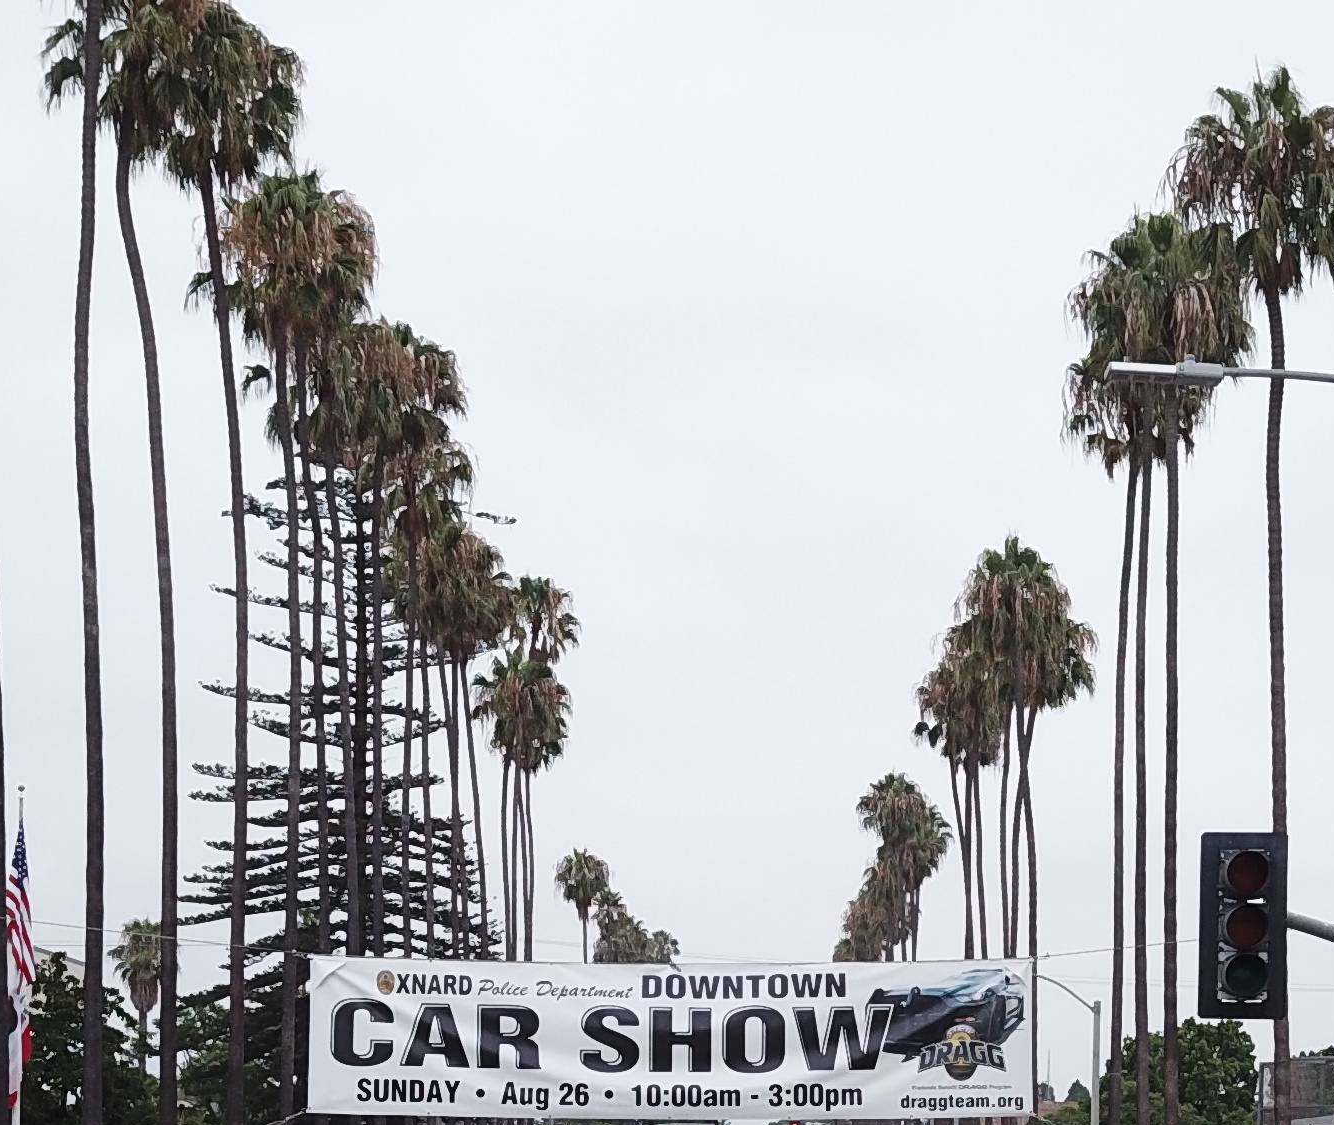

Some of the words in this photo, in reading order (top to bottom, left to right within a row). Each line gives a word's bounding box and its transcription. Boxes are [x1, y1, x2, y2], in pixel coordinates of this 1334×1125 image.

[477, 978, 529, 997] Police
[535, 980, 634, 1001] Department
[641, 972, 847, 999] DOWNTOWN
[329, 997, 542, 1070] CAR
[579, 1003, 895, 1074] SHOW
[917, 1039, 1008, 1074] DRAGG
[356, 1078, 461, 1104] SUNDAY
[501, 1081, 550, 1111] Aug
[557, 1082, 591, 1107] 26
[630, 1083, 741, 1108] 10:00am
[768, 1083, 863, 1112] 3:00pm
[900, 1094, 1024, 1112] draggteam.org
